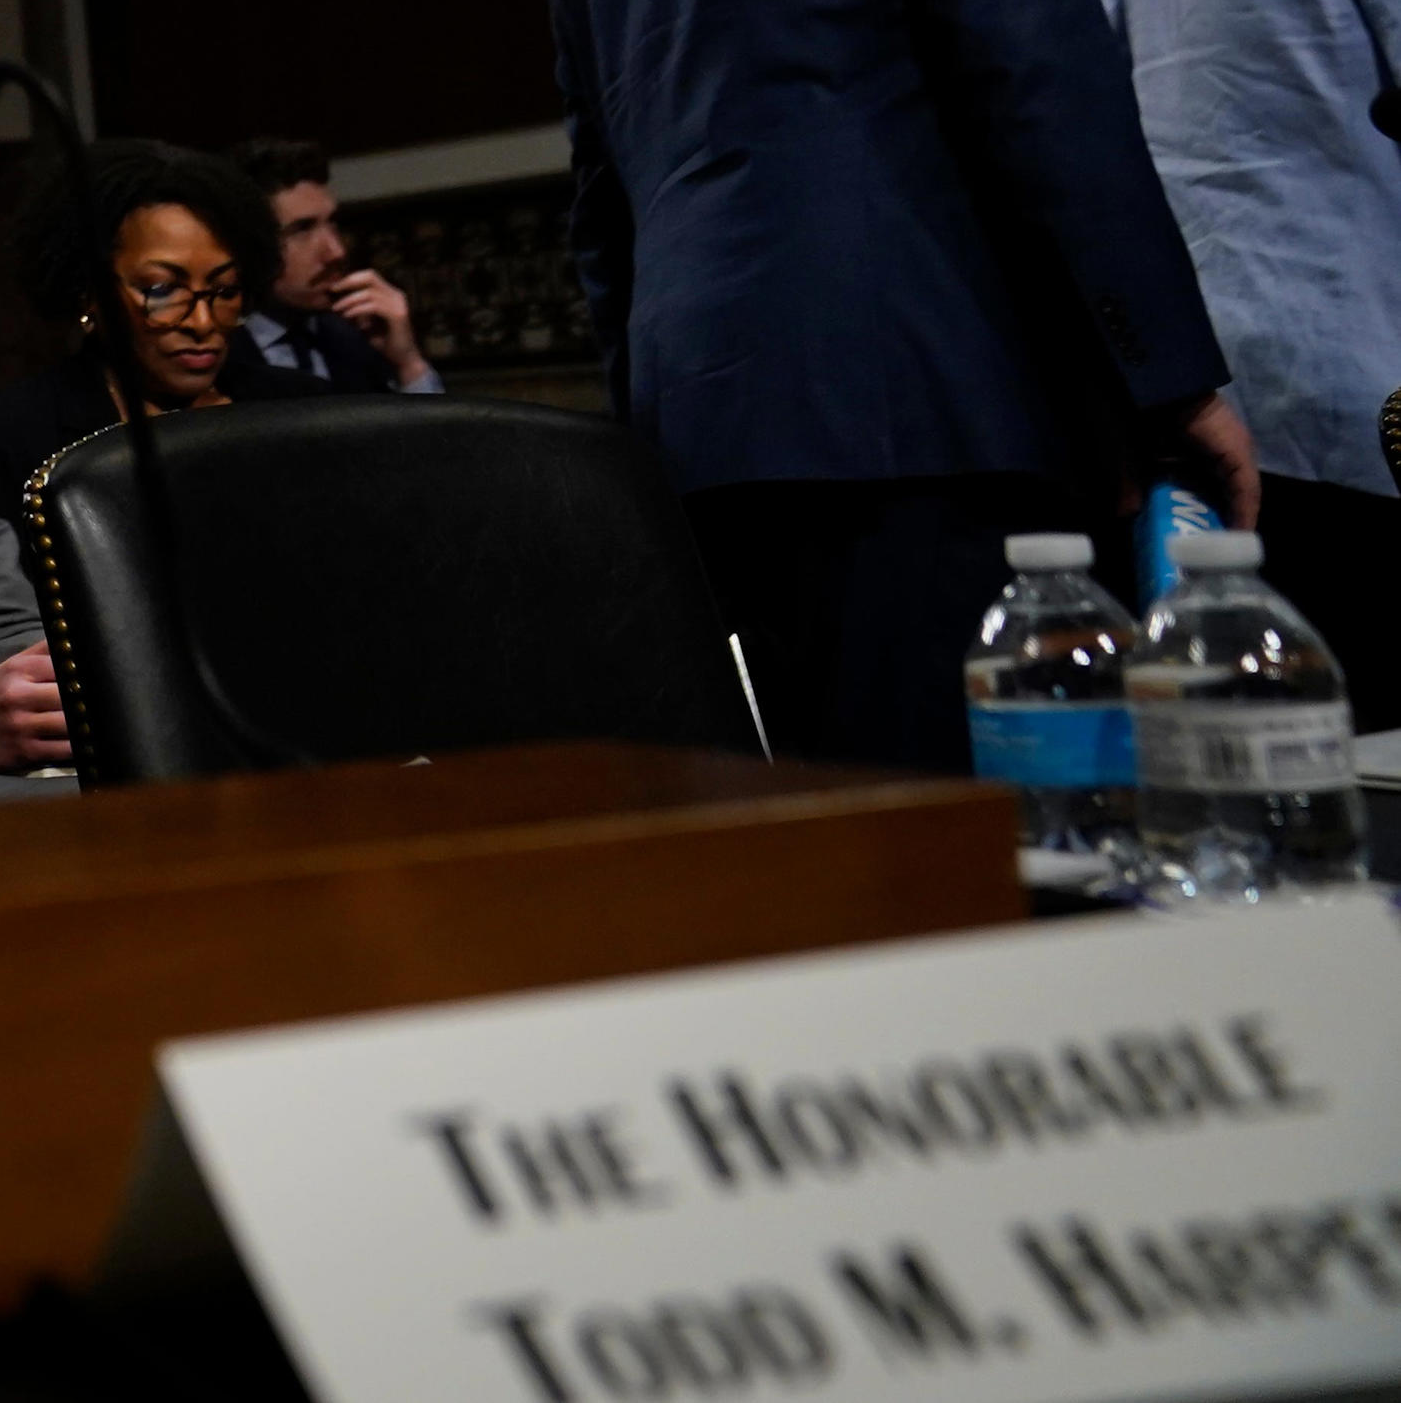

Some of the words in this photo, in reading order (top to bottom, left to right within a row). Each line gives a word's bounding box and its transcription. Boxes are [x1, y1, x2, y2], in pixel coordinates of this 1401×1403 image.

[410, 1103, 672, 1231] THE
[664, 1013, 1326, 1191] HONORABLE
[470, 1287, 834, 1403] TODD
[830, 1237, 1030, 1361] M.
[1008, 1201, 1401, 1335] HARPE
